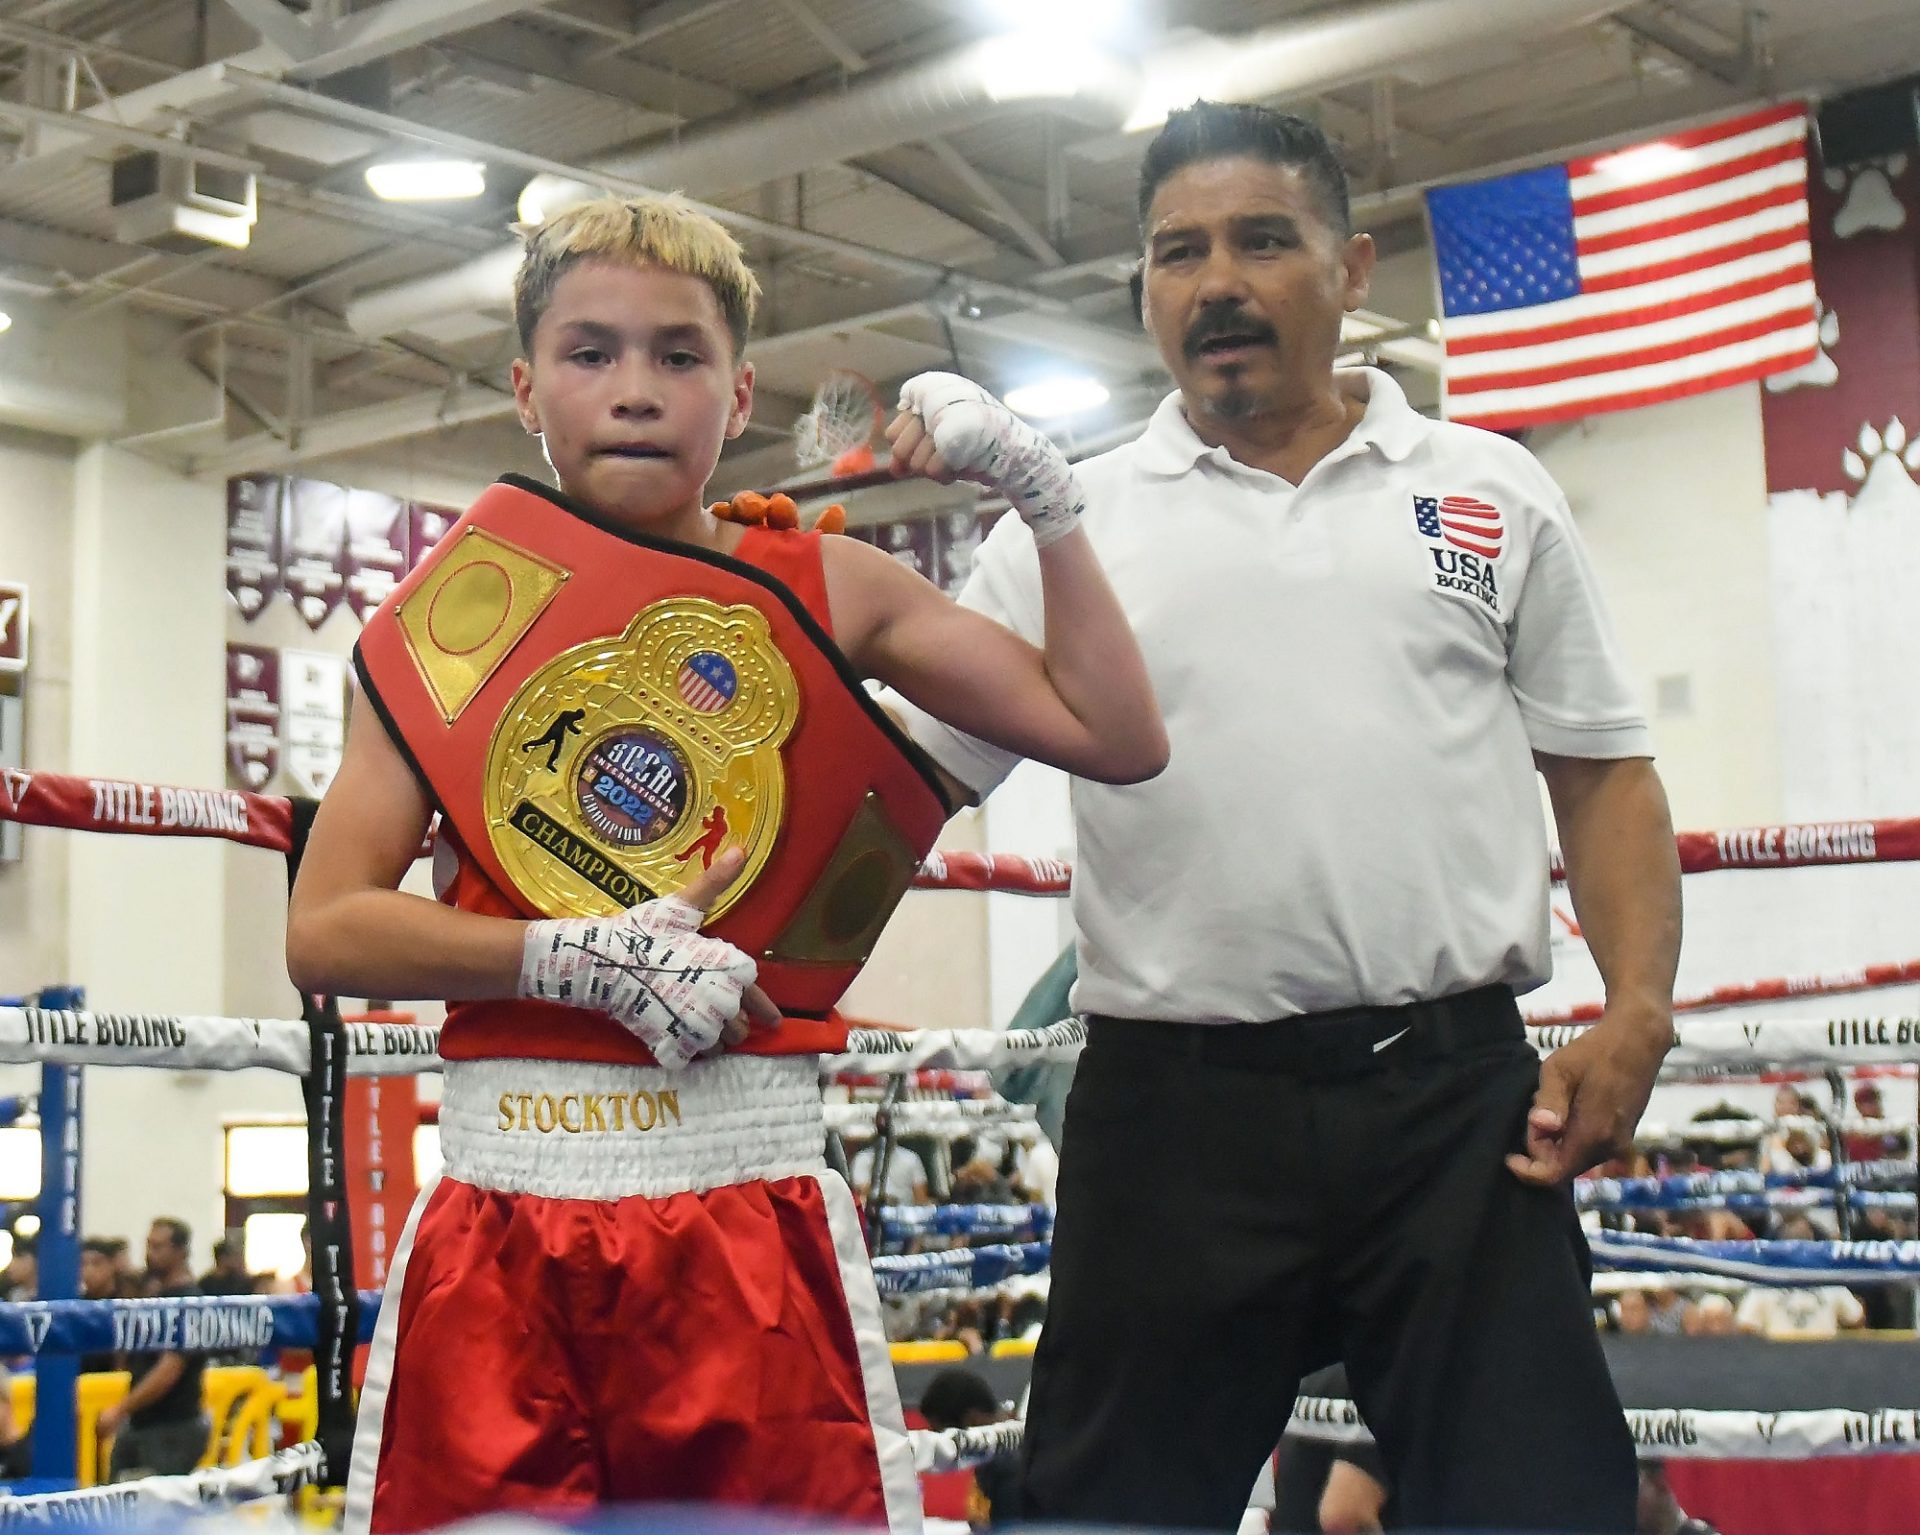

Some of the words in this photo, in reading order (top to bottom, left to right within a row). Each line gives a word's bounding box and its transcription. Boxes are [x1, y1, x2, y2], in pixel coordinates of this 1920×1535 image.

[1429, 547, 1498, 595] USA
[1435, 573, 1498, 611] BOXING
[90, 779, 156, 825] TITLE
[161, 787, 249, 832] BOXING
[593, 754, 676, 818] INTERNATIONAL
[594, 775, 654, 825] 2022
[522, 813, 650, 905] CHAMPION
[1717, 827, 1780, 863] TITLE
[1784, 823, 1876, 859] BOXING
[25, 1007, 88, 1045] TITLE
[96, 1012, 187, 1047] BOXING
[384, 1026, 438, 1055] BOXI
[322, 1032, 335, 1187] TITLE
[498, 1089, 681, 1133] STOCKTON
[114, 1310, 181, 1350] TITLE
[184, 1305, 274, 1349] BOXING
